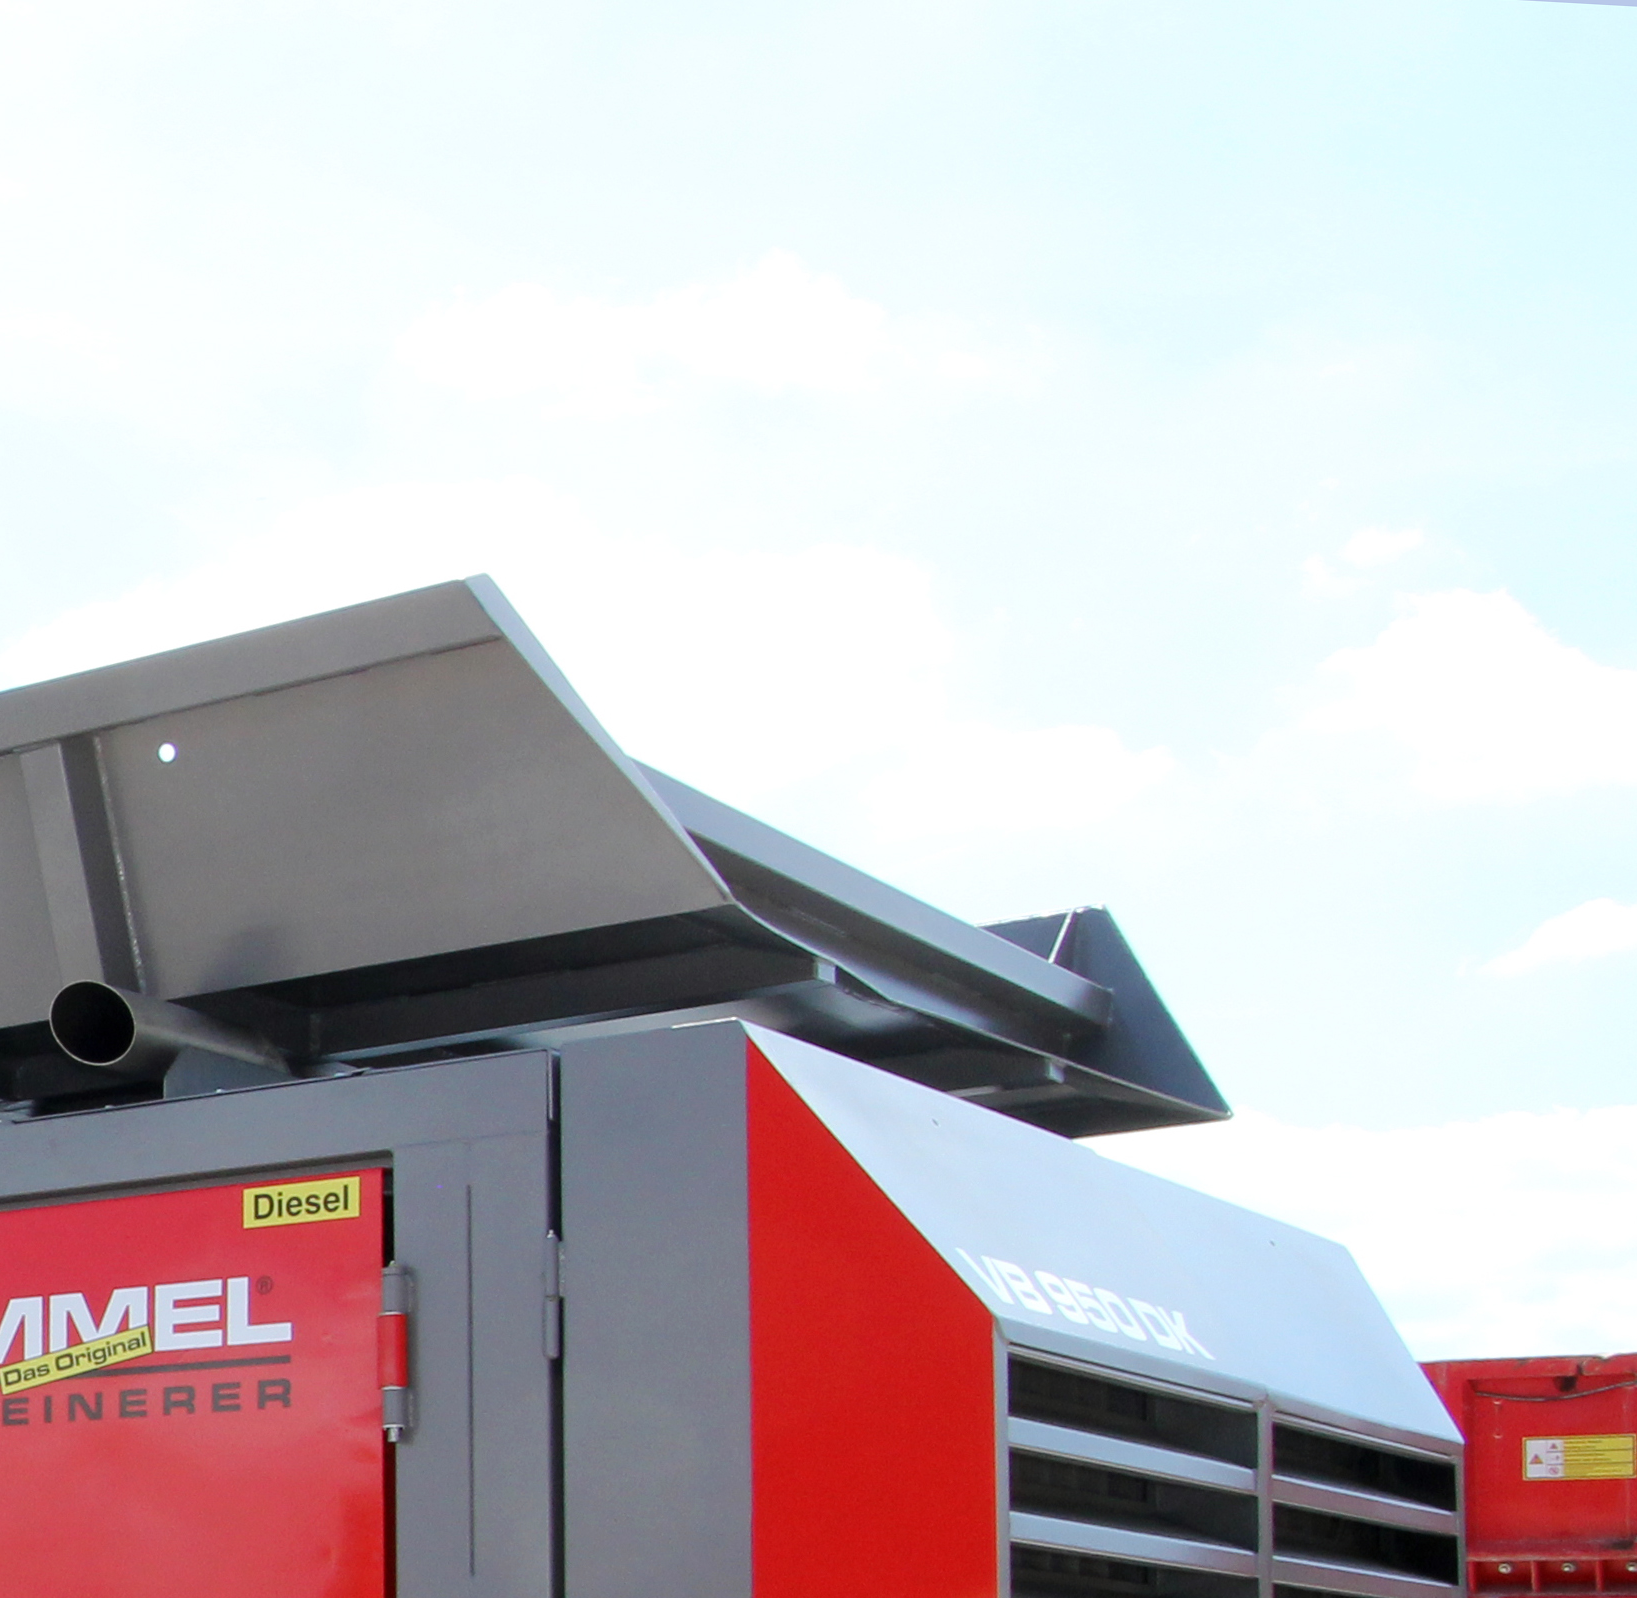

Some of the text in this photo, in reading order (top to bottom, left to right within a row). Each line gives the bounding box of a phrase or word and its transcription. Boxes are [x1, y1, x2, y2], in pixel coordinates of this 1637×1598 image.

[253, 1184, 349, 1220] Diesel
[955, 1247, 1216, 1361] VB 950 DK
[2, 1330, 147, 1387] Das Original
